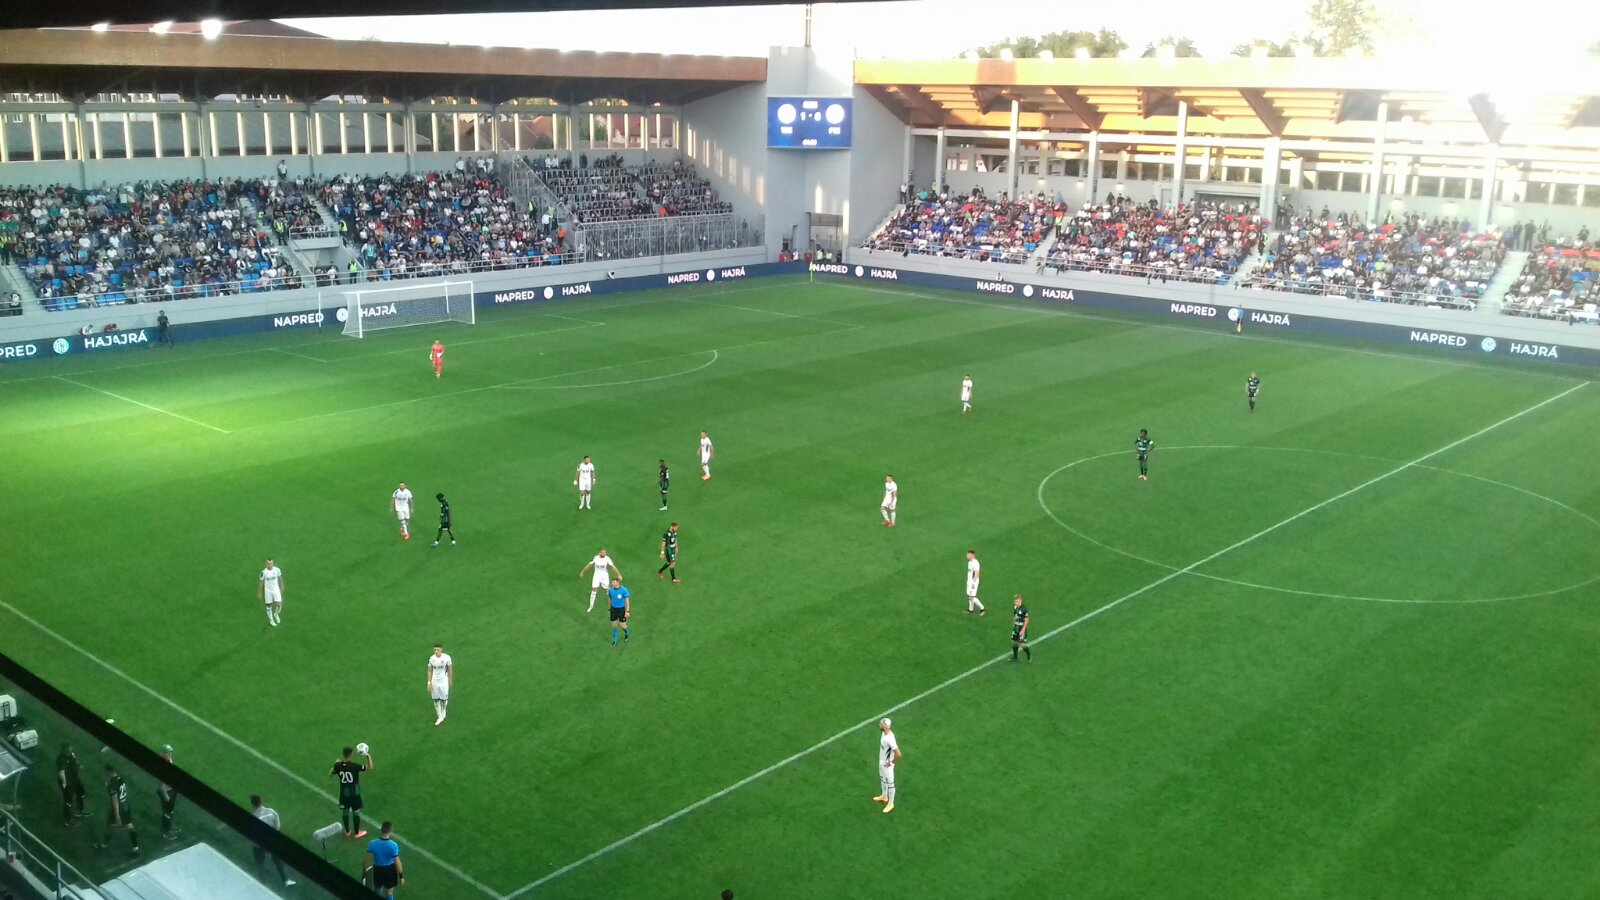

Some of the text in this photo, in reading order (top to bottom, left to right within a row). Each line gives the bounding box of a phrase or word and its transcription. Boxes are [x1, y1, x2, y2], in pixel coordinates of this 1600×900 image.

[667, 266, 746, 285] NAPRED HAJRÁ
[813, 263, 898, 280] NAPRED HAJRÁ
[495, 282, 592, 303] NAPRED HAJRÁ
[976, 281, 1074, 300] NAPRED HAJRÁ
[274, 303, 397, 328] NAPRED HAJRÁ
[1170, 303, 1291, 326] NAPRED HAJRÁ
[1410, 330, 1559, 359] NAPRED HAJRÁ
[339, 771, 354, 784] 20
